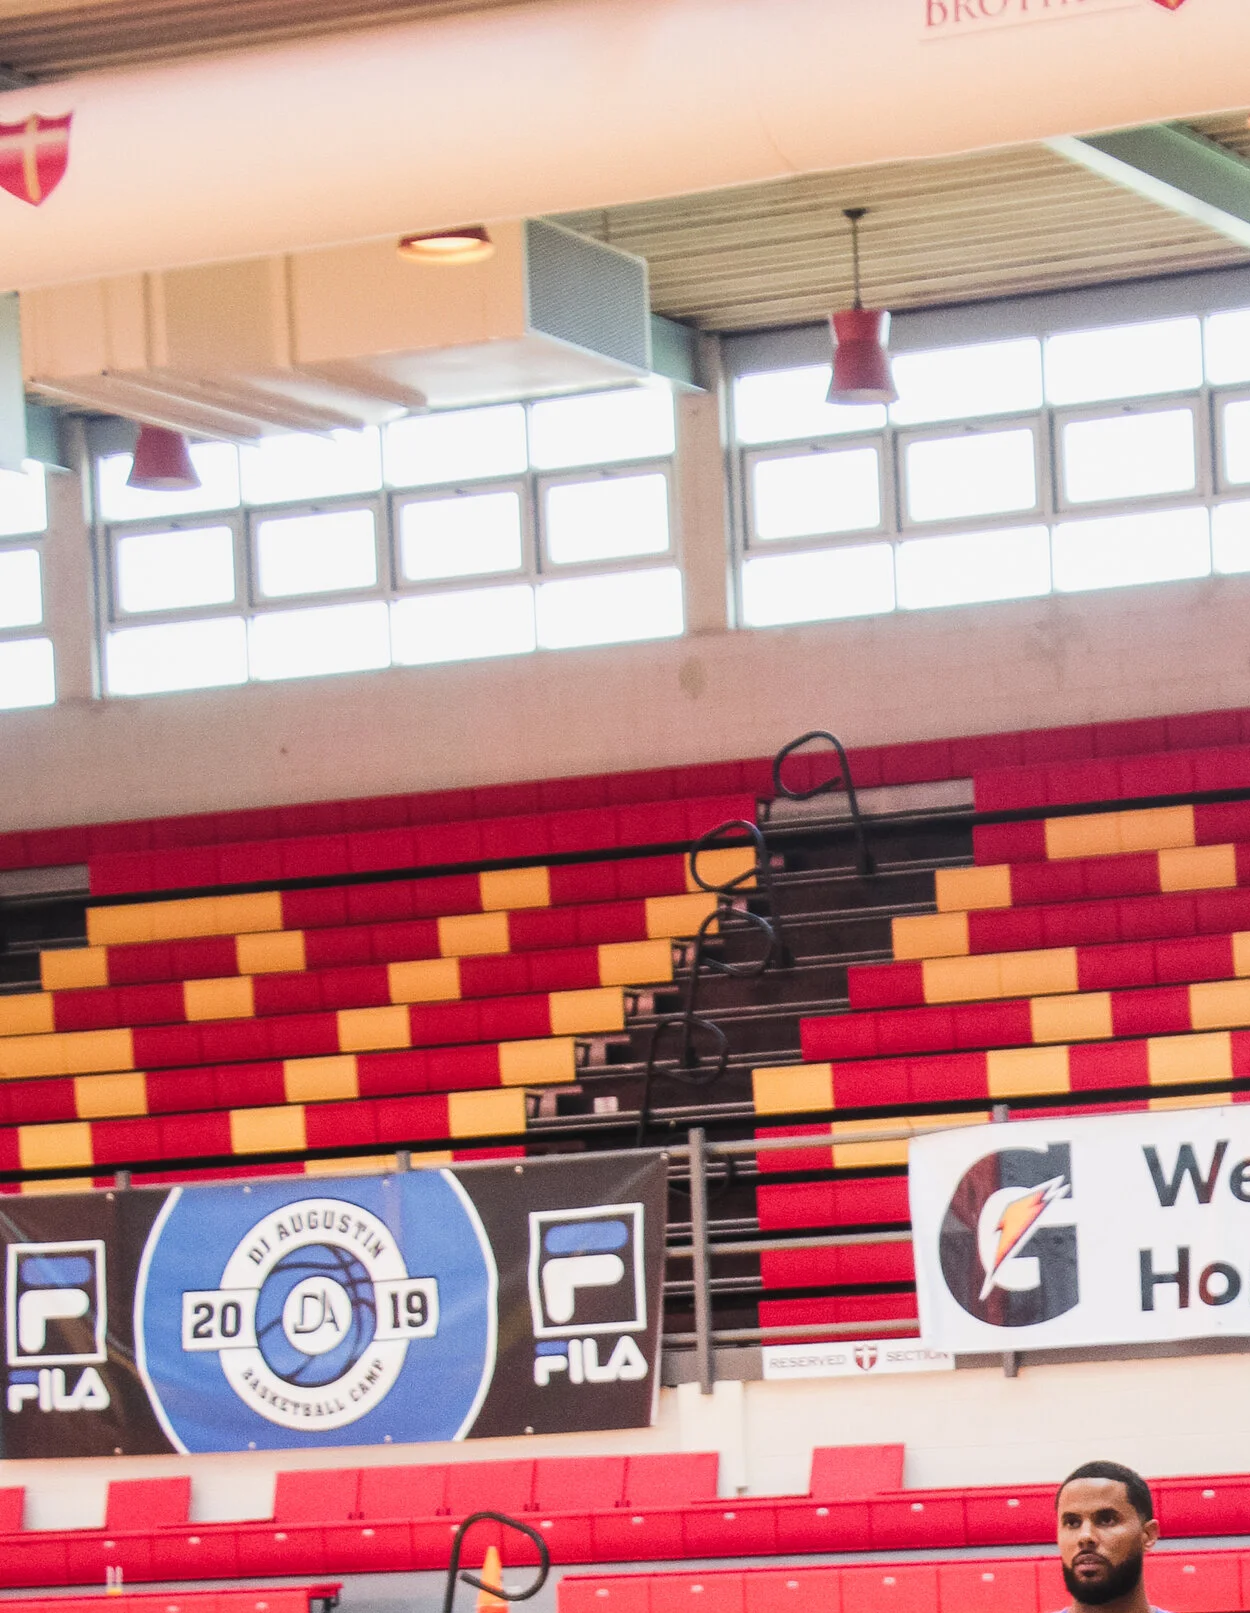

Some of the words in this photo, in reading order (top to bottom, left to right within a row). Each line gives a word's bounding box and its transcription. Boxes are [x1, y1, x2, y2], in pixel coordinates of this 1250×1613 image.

[247, 1238, 271, 1265] DJ
[277, 1210, 387, 1261] AUGUSTIN
[938, 1141, 1080, 1328] G
[192, 1301, 241, 1338] 20
[389, 1290, 428, 1328] 19
[534, 1335, 648, 1386] FILA
[769, 1354, 846, 1368] RESERVED
[886, 1350, 950, 1362] SECTION
[7, 1367, 110, 1413] FILA
[241, 1367, 345, 1417] BASKETBALL
[349, 1358, 385, 1401] CAMP
